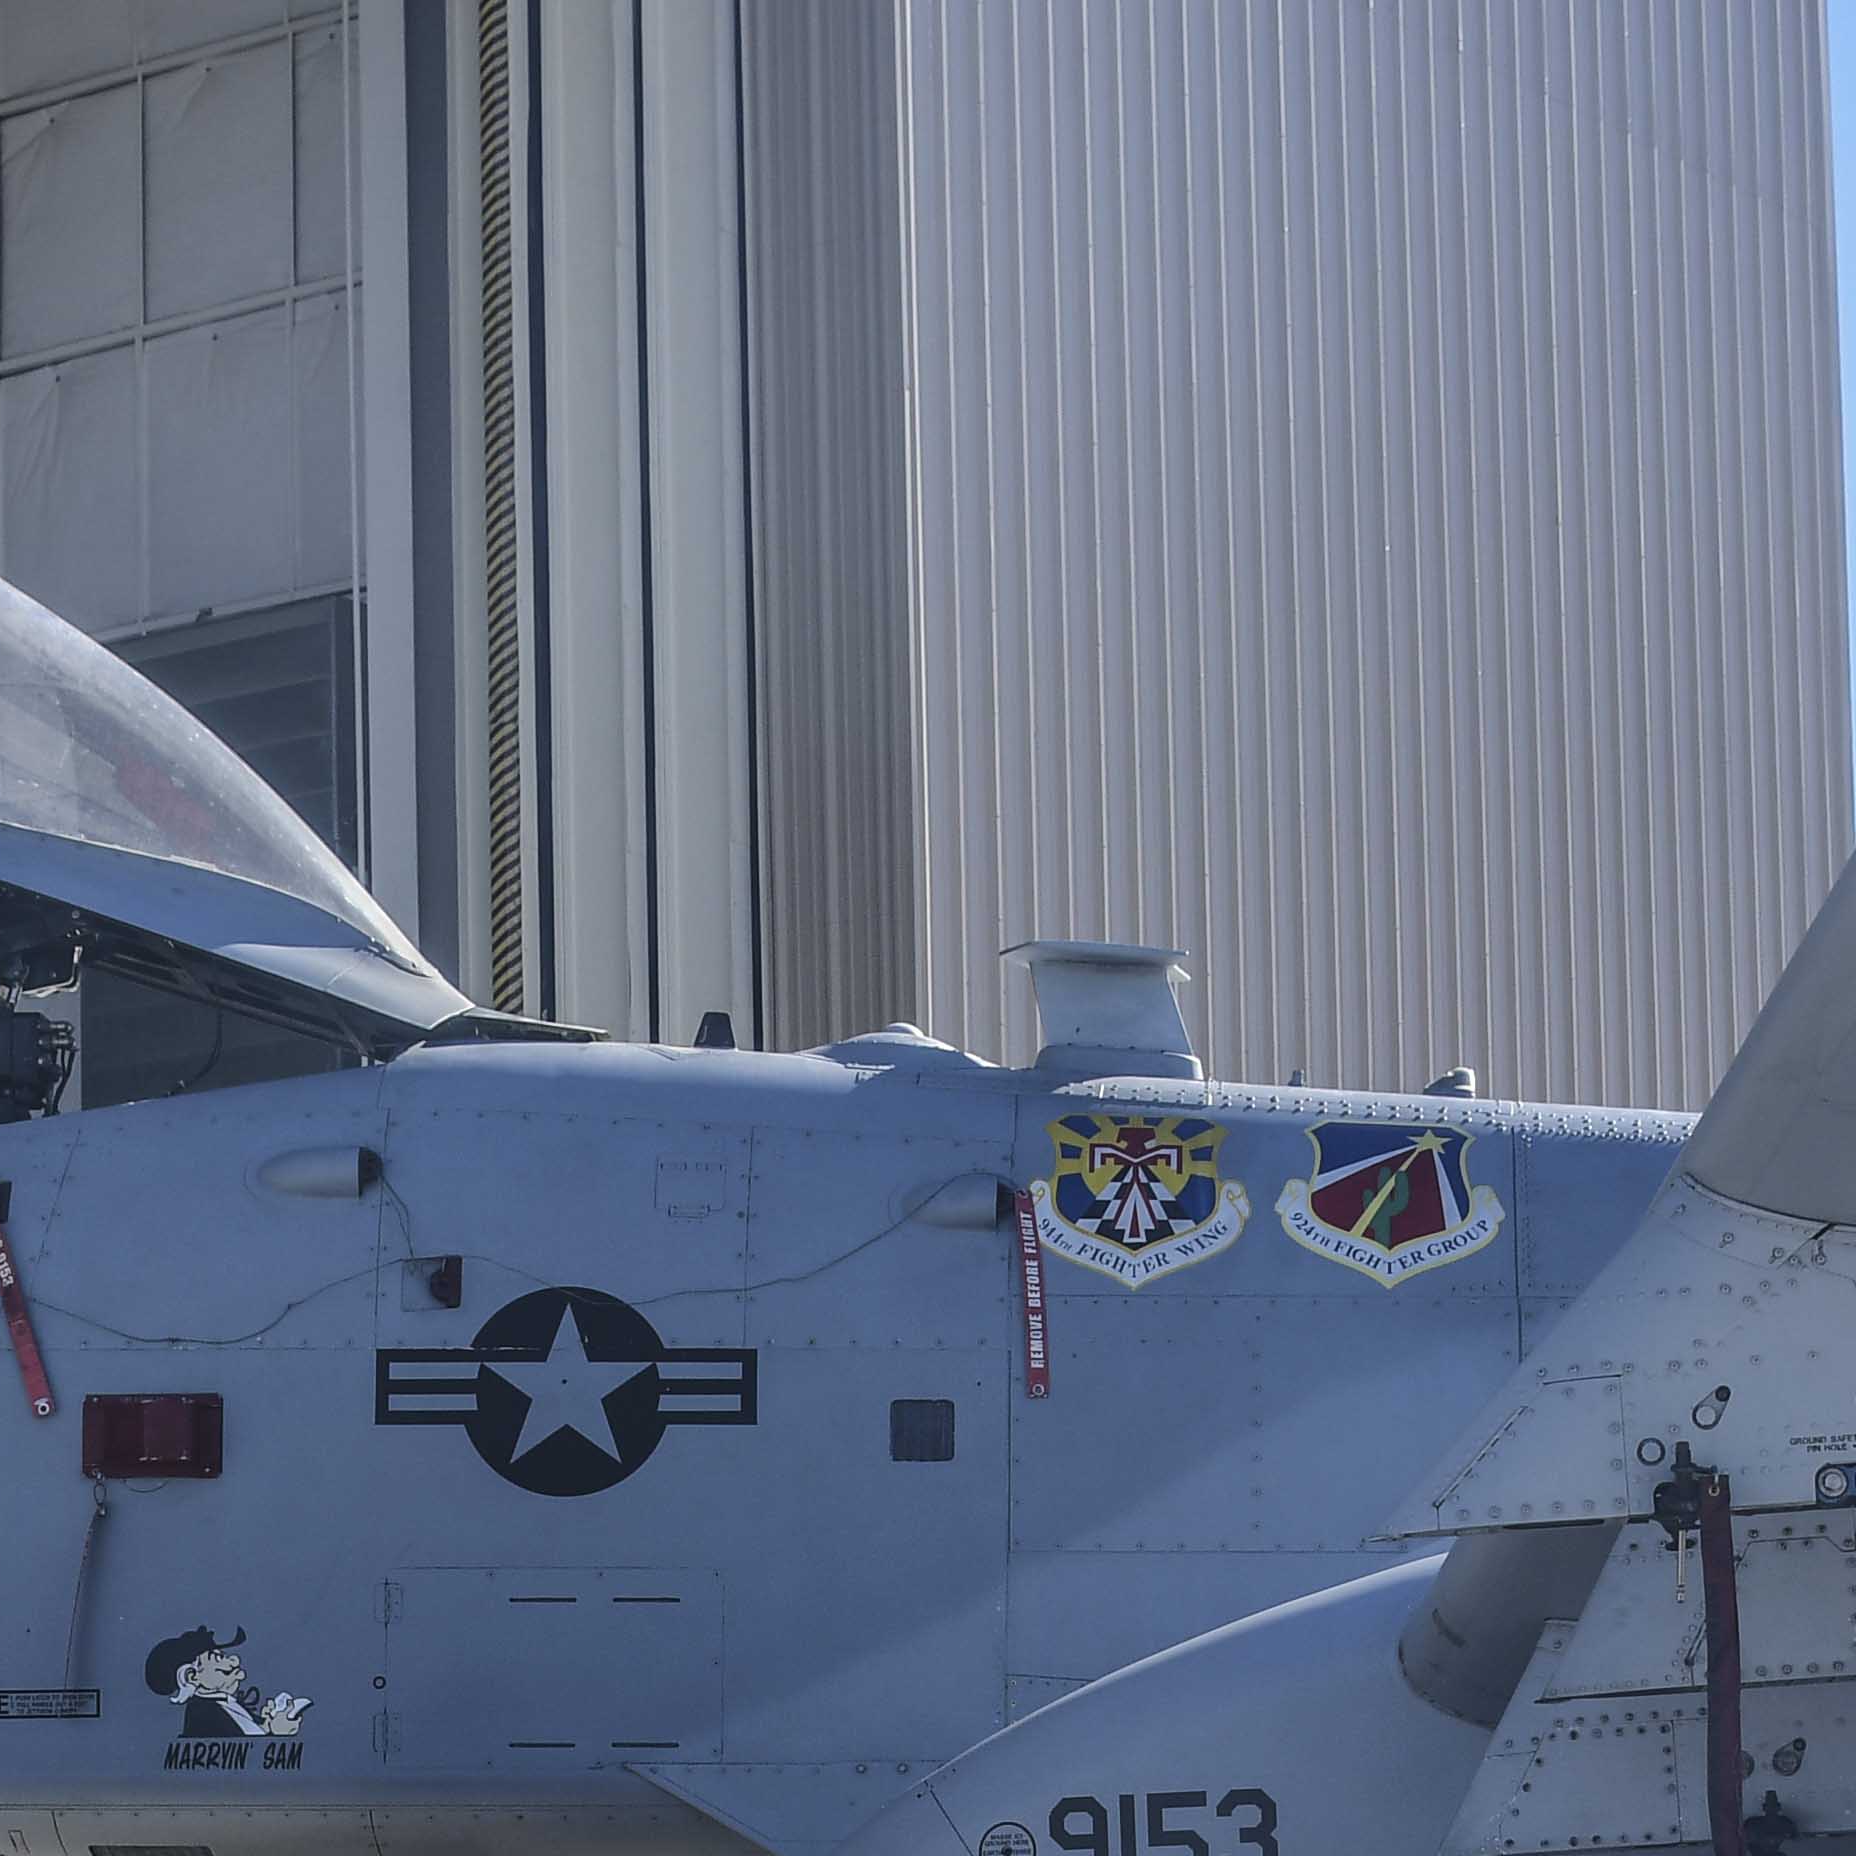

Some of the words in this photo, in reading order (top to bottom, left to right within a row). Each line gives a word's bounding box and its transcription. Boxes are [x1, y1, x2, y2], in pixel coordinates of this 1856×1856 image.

[1020, 1212, 1038, 1253] FLIGHT
[1077, 1244, 1170, 1279] FIGHTER
[1176, 1221, 1230, 1261] WING
[1332, 1240, 1425, 1276] FIGHTER
[1426, 1219, 1491, 1259] GROUP
[1025, 1259, 1041, 1308] BEFORE
[1029, 1313, 1044, 1368] REMOVE
[1789, 1436, 1827, 1446] GROUND
[164, 1741, 254, 1771] MARRYIN'
[263, 1742, 304, 1771] SAM
